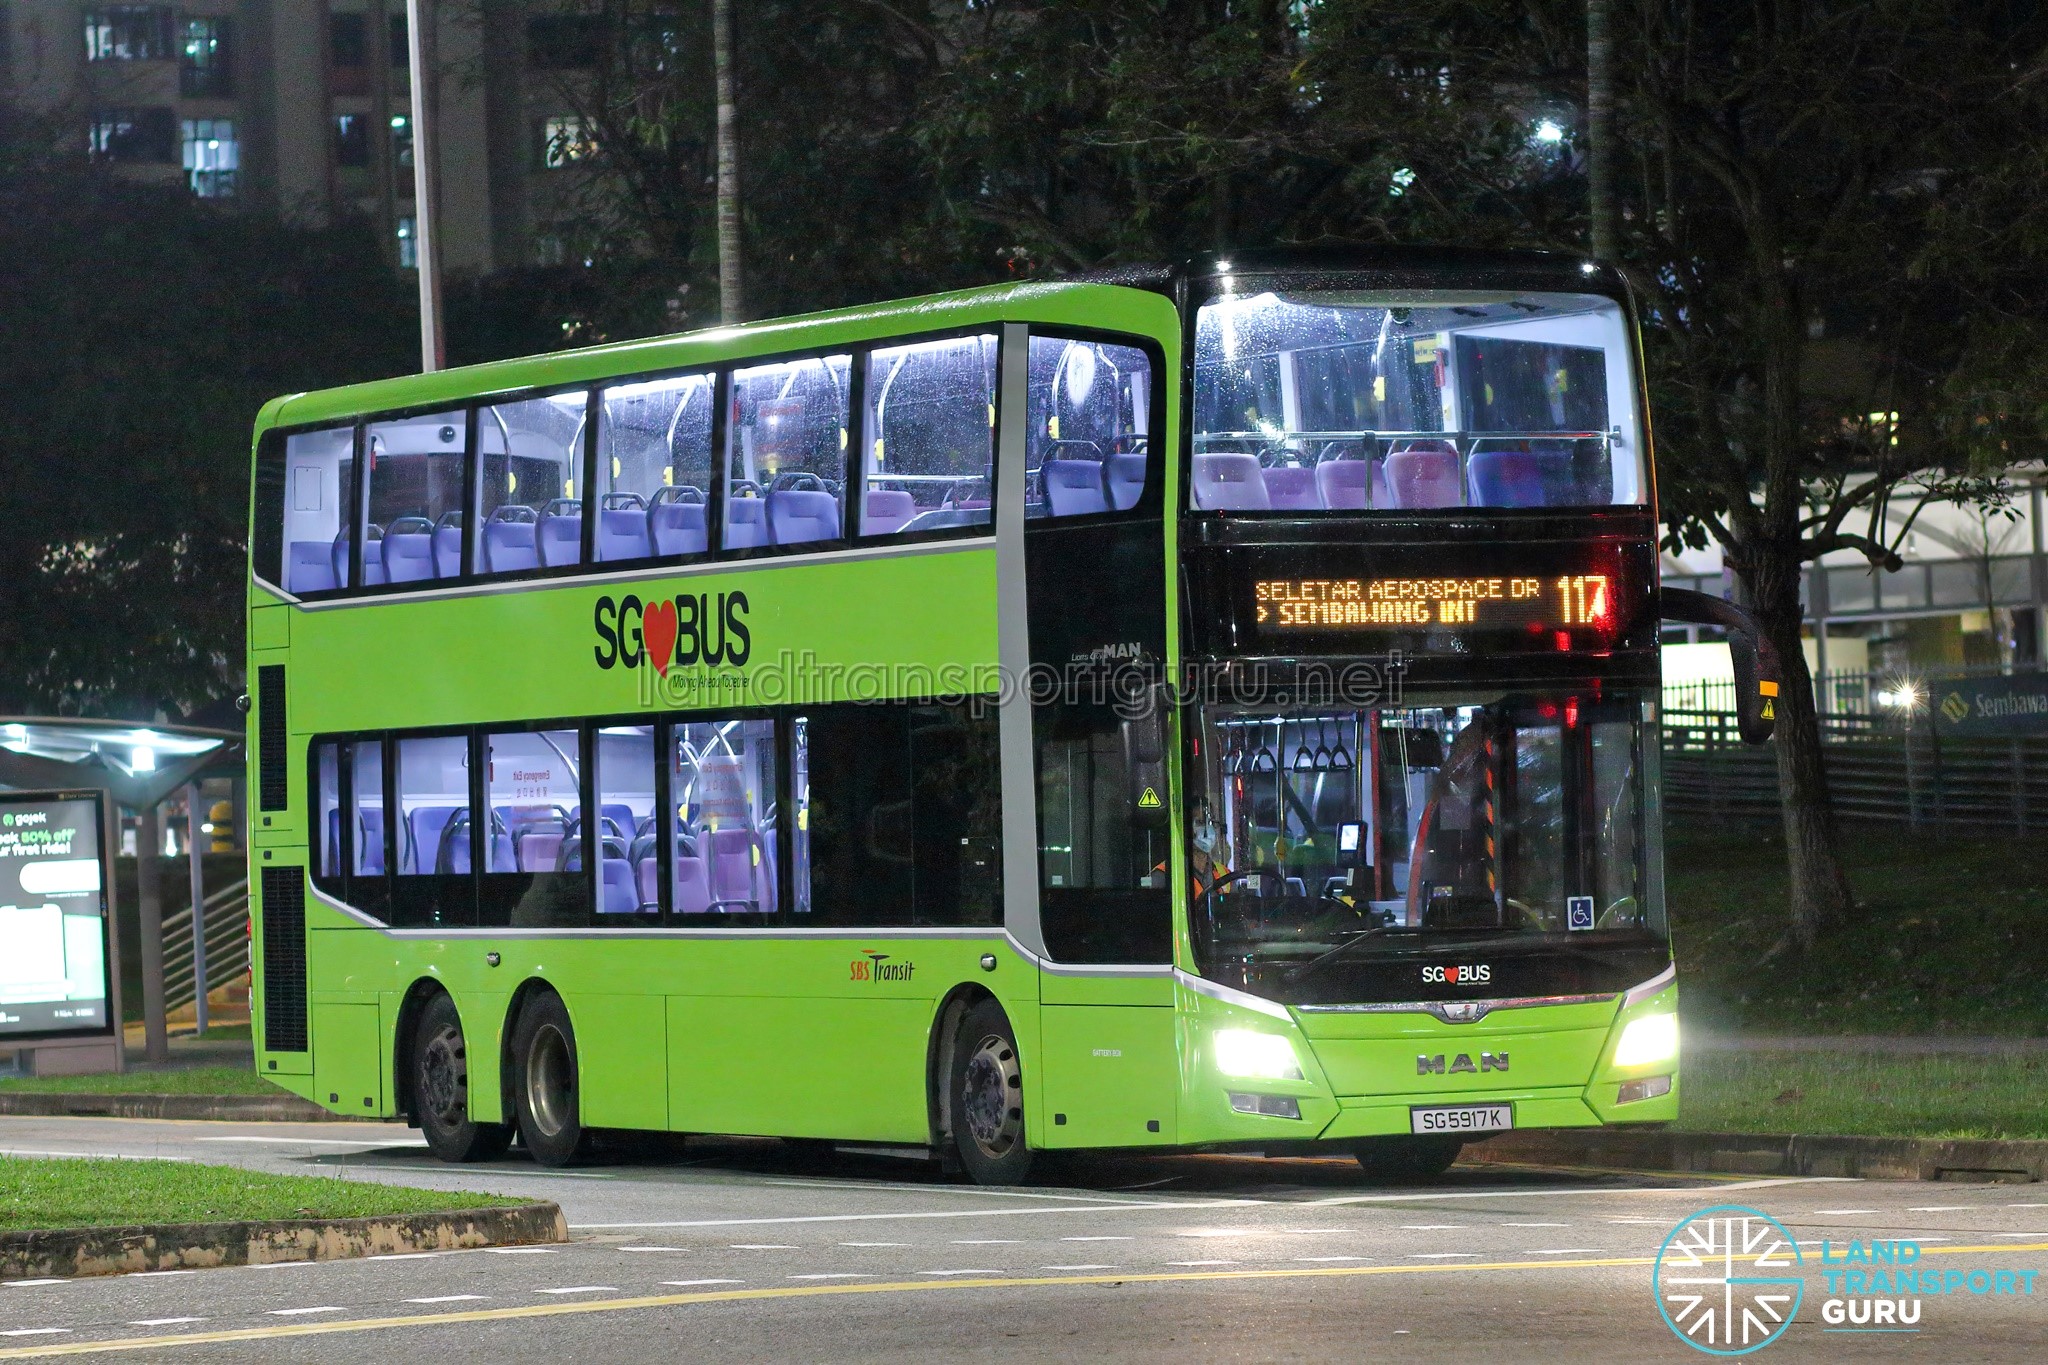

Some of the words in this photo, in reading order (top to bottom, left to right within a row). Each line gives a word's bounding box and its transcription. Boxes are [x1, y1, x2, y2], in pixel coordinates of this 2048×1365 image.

[1256, 581, 1361, 600] SELETAR
[1369, 580, 1503, 599] AEROSPACE
[1511, 579, 1540, 598] DR
[1557, 575, 1607, 623] 117
[1279, 601, 1431, 625] SEMBAWANG
[1439, 600, 1476, 623] INT
[675, 591, 751, 667] BUS
[1103, 642, 1141, 659] MAN
[672, 675, 698, 691] Moving
[699, 674, 720, 689] Ahead
[721, 673, 750, 691] Together
[15, 812, 47, 827] gojek
[21, 830, 52, 844] 50%
[53, 828, 76, 842] off
[12, 842, 40, 856] first
[41, 841, 71, 855] ride!
[850, 960, 870, 981] SBS
[868, 954, 916, 984] Transit
[1422, 966, 1446, 983] SG
[1458, 964, 1491, 982] BUS
[1416, 1051, 1510, 1076] MAN
[1423, 1109, 1502, 1130] SG5917K
